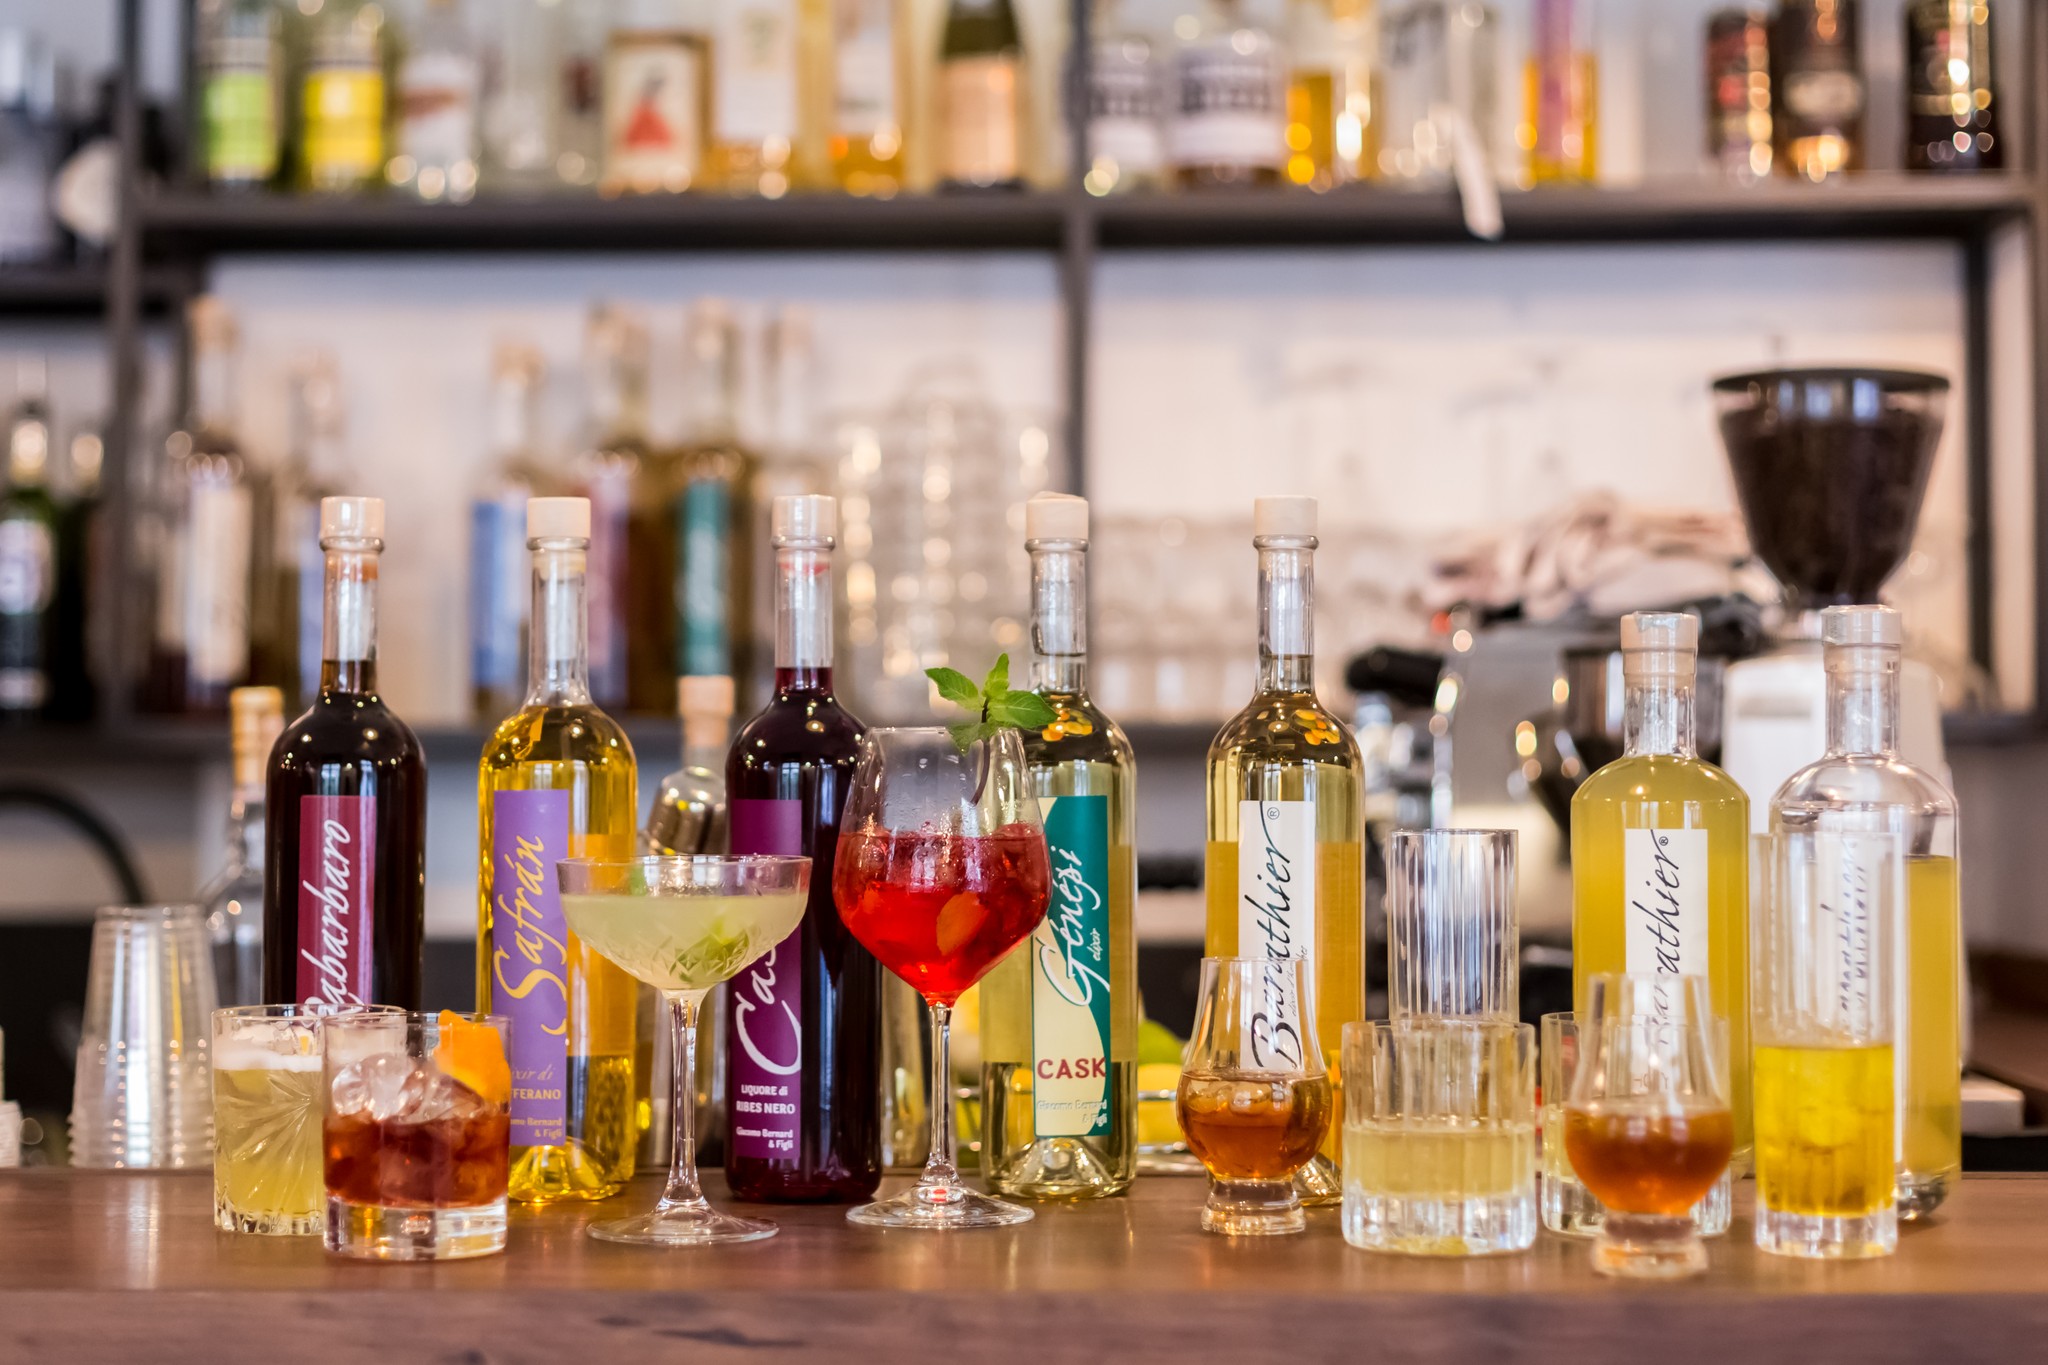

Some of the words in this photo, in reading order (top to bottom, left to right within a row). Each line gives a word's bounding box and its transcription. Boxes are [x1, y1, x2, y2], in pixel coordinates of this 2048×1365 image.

[493, 834, 567, 1036] Safrán
[537, 1063, 556, 1081] di
[1037, 1056, 1107, 1080] CASK
[740, 1084, 778, 1097] LIQUORE
[778, 1085, 788, 1096] di
[736, 1100, 762, 1113] RIBES
[763, 1102, 796, 1114] NERO
[527, 1116, 563, 1127] Bernard
